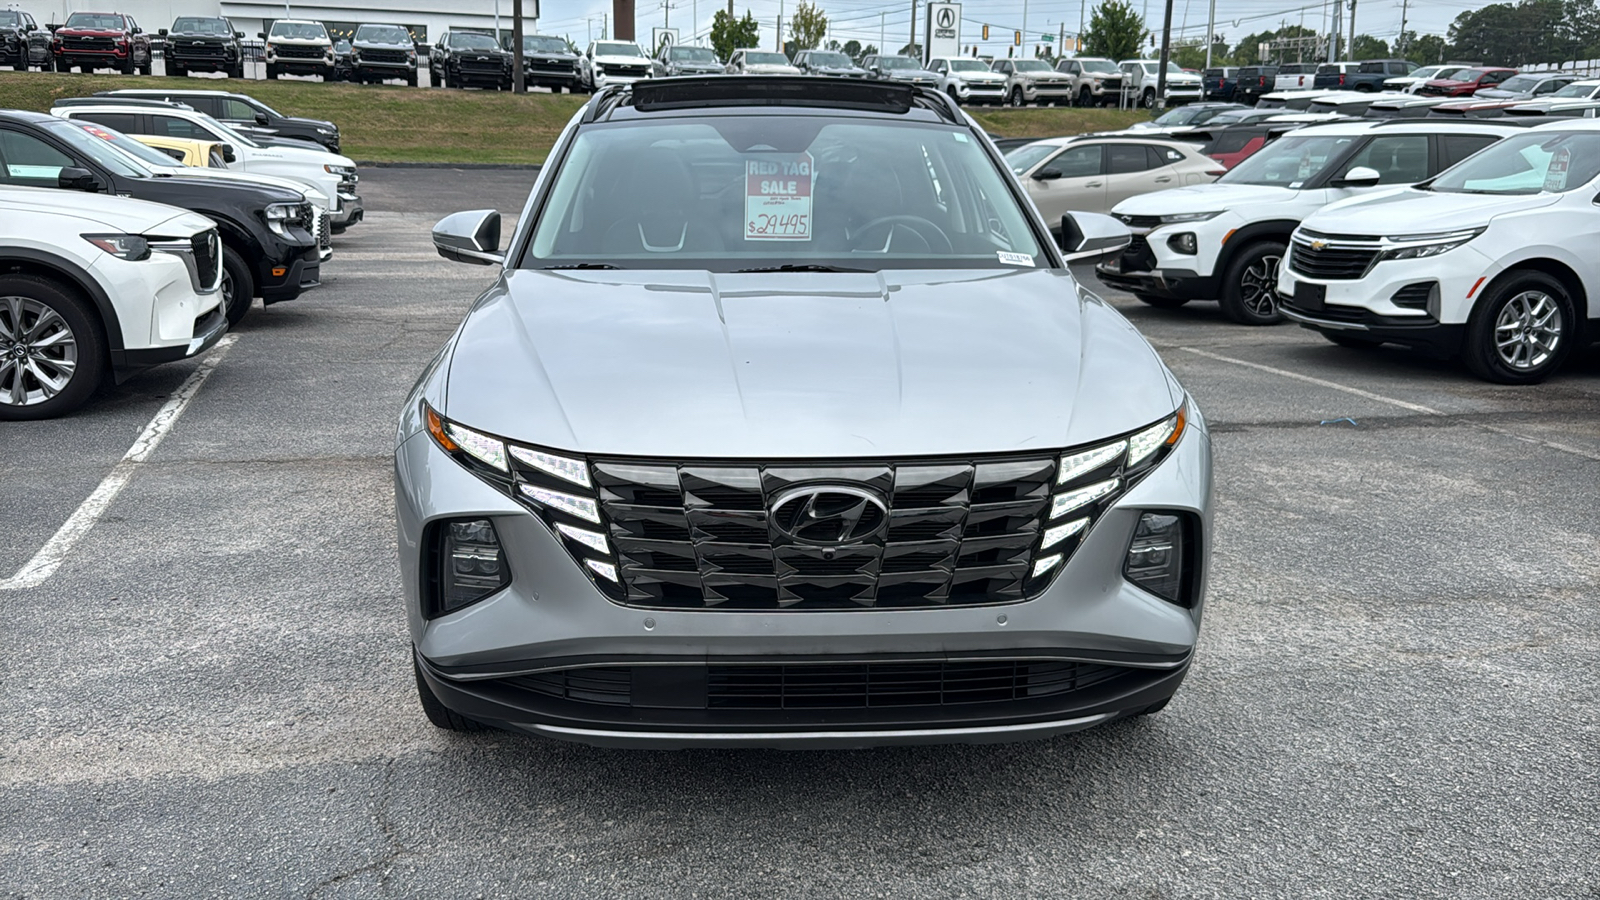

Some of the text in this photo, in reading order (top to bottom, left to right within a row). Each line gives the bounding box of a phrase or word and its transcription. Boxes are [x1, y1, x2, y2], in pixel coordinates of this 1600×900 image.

[749, 161, 810, 176] RED TAG
[761, 181, 797, 194] SALE
